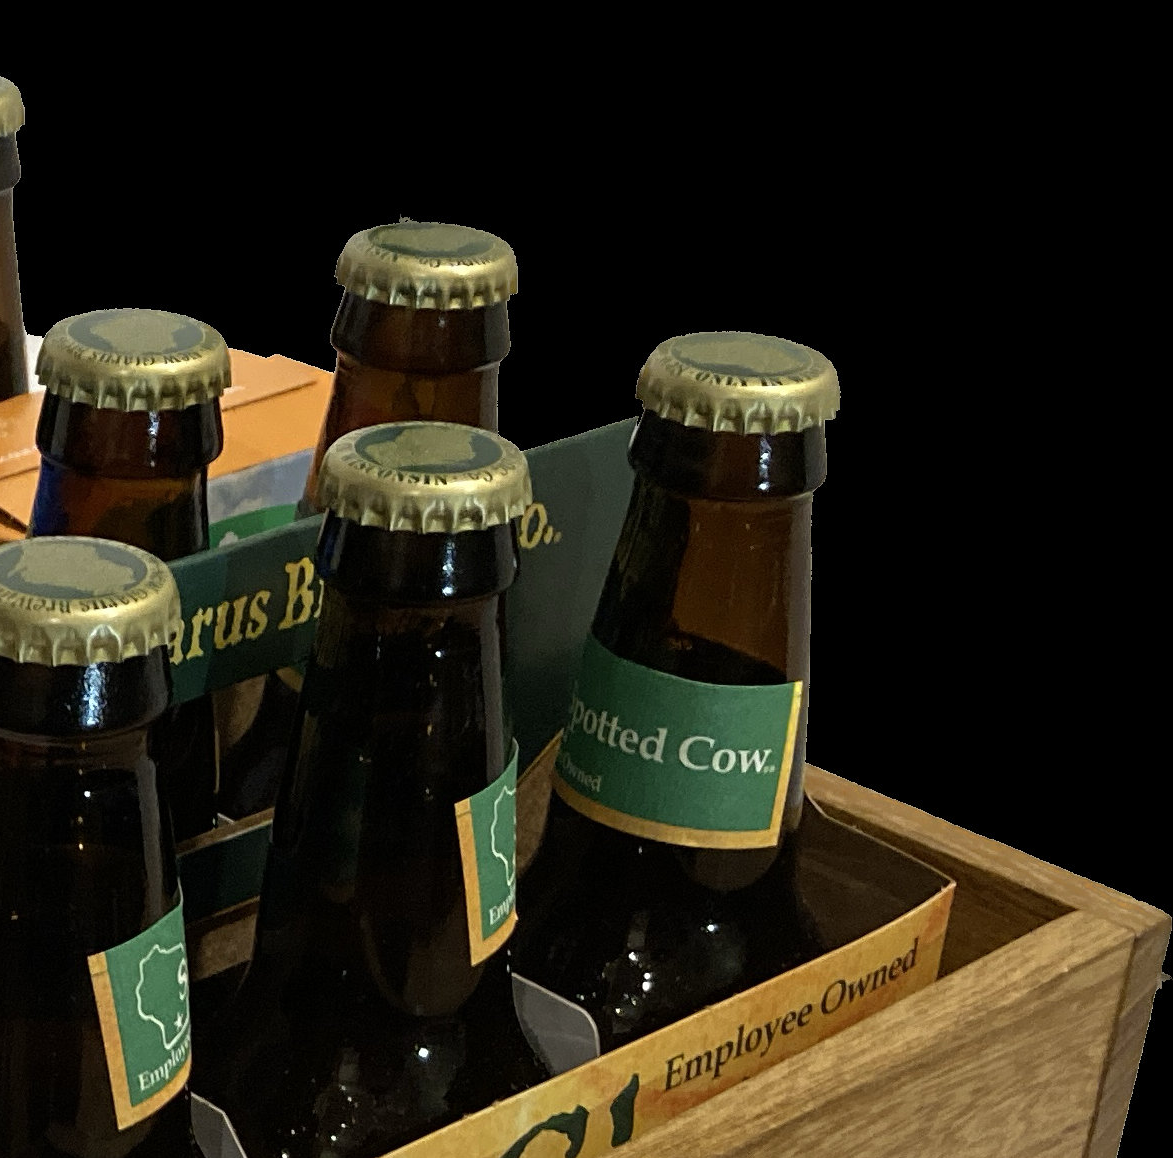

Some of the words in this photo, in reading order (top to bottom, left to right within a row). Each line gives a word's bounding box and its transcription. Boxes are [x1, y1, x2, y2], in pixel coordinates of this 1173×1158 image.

[167, 590, 271, 665] arus
[570, 697, 668, 764] potted
[665, 1003, 813, 1092] Employee
[820, 936, 919, 1015] Owned
